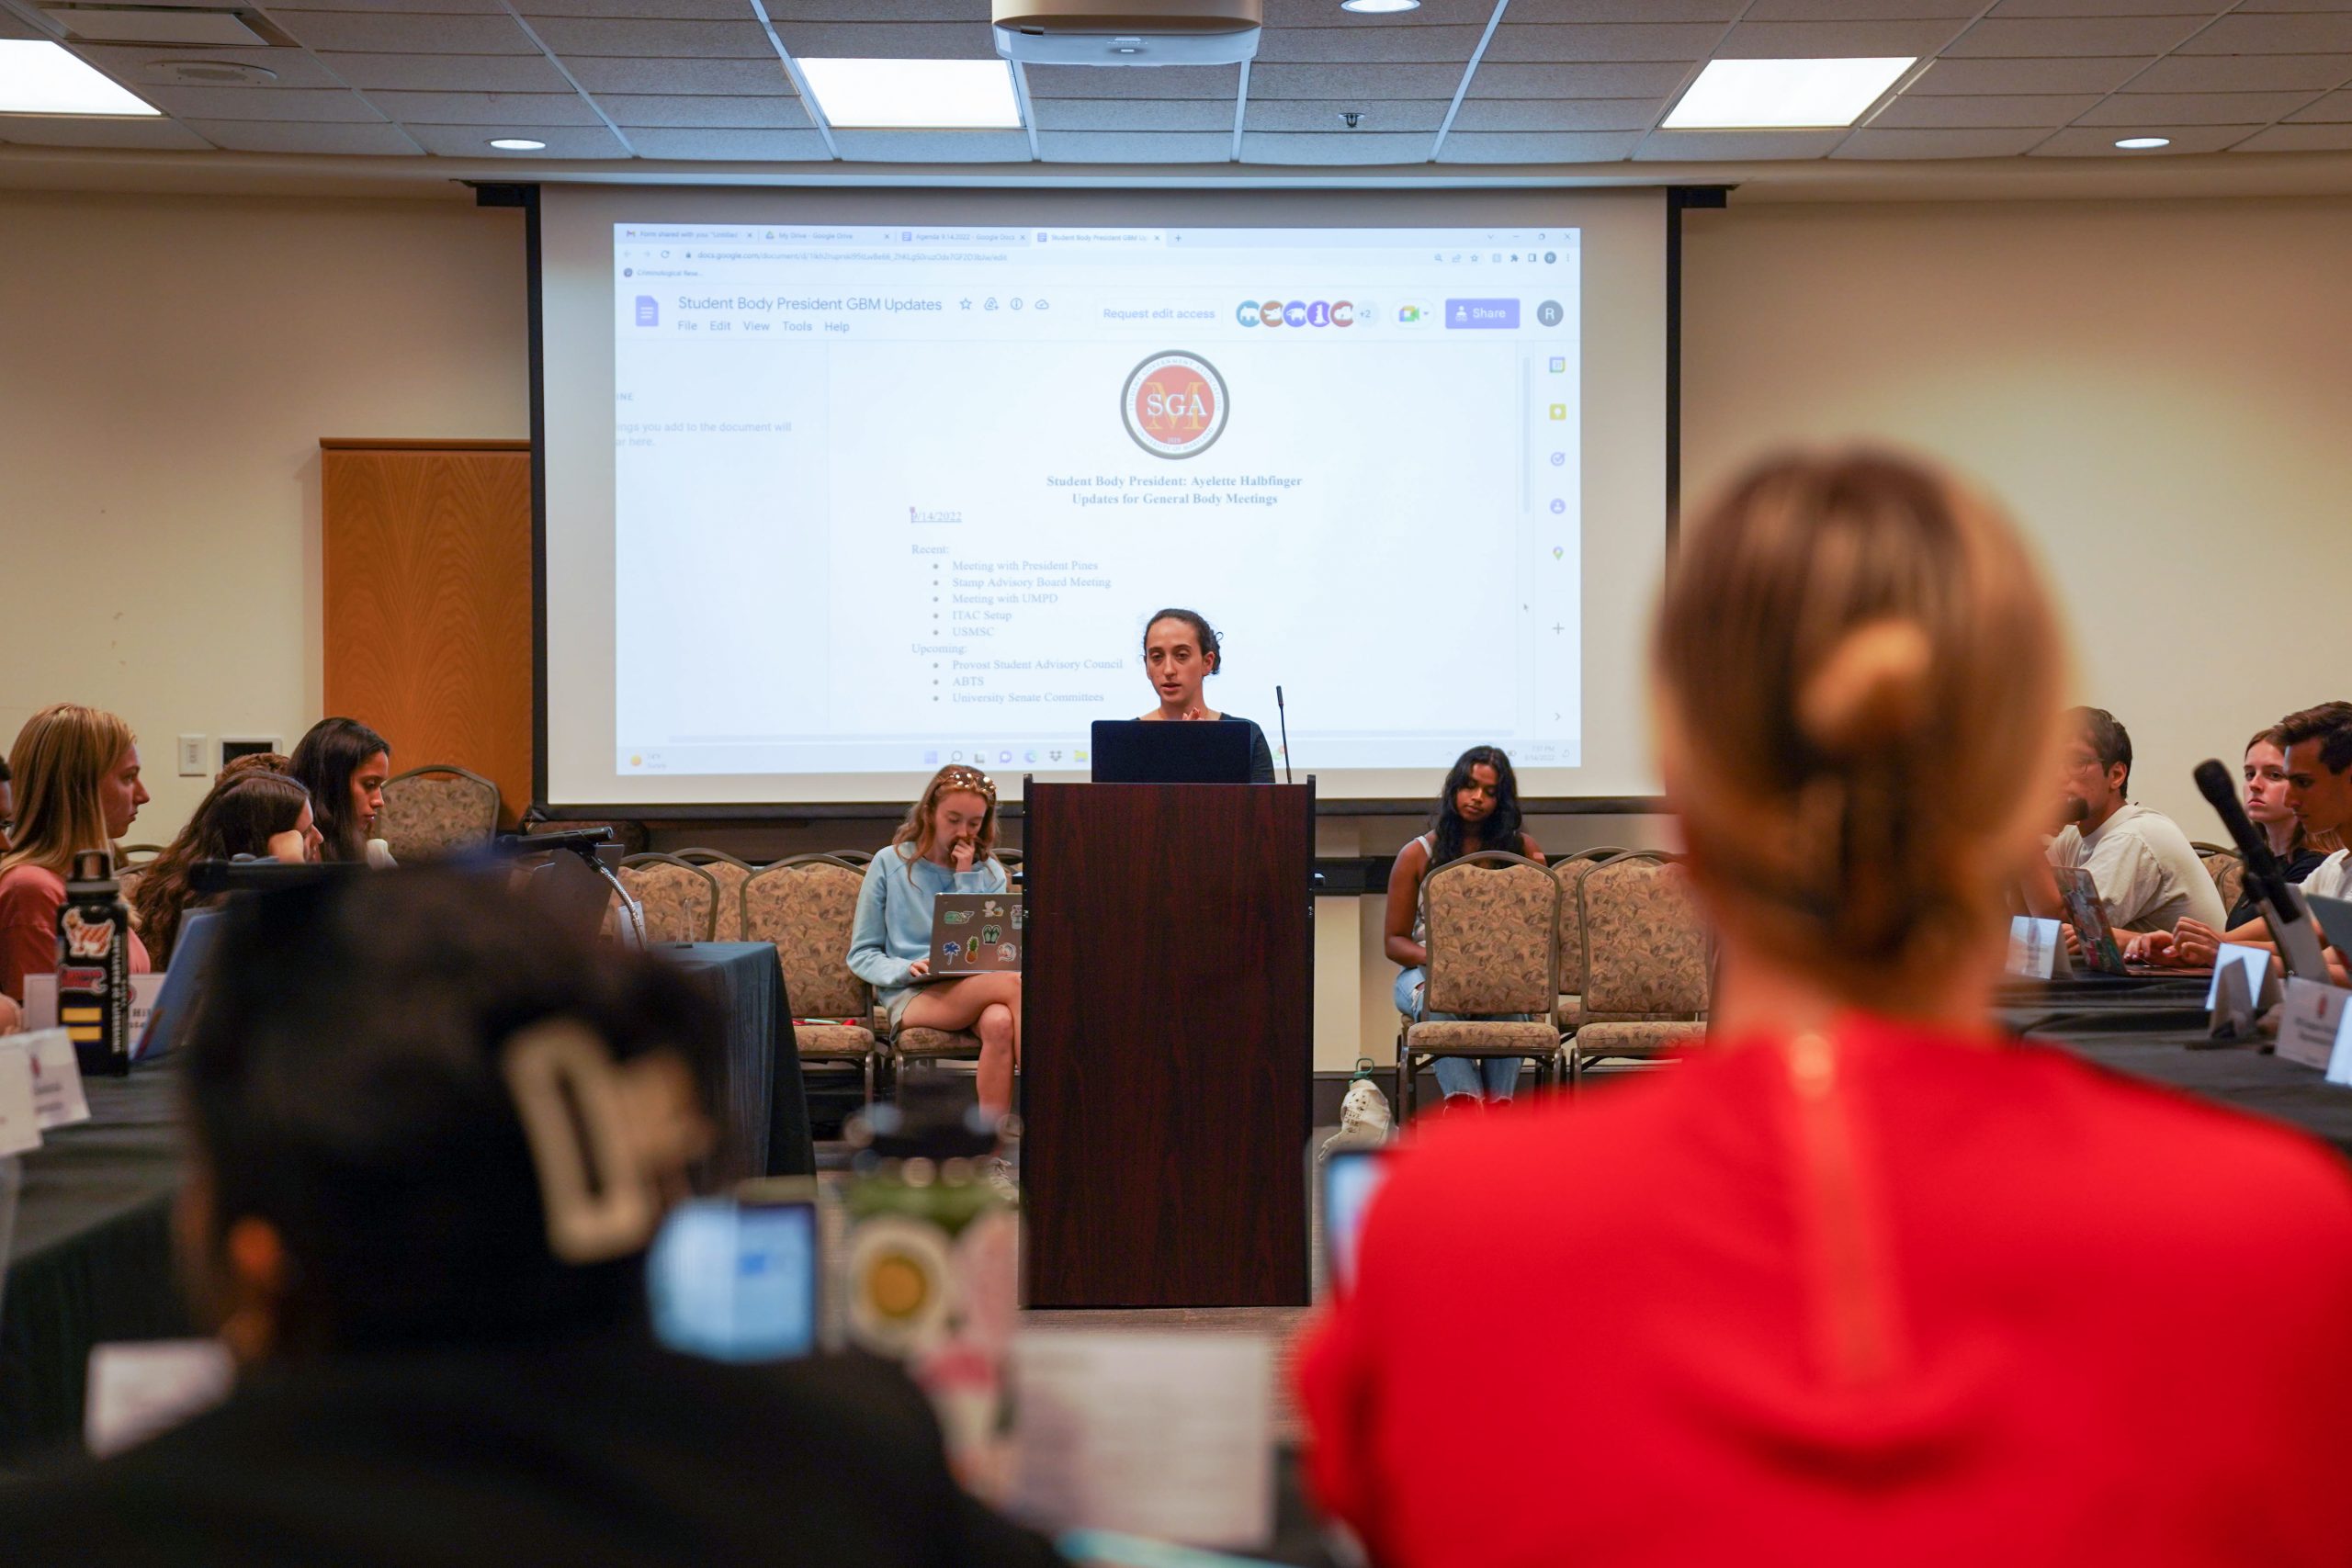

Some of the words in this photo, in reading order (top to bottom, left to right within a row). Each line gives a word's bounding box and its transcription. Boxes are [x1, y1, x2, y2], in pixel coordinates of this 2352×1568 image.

[794, 231, 809, 240] Drive
[813, 231, 835, 242] Google
[837, 231, 853, 241] Drive
[977, 233, 998, 243] Google
[1000, 233, 1015, 242] Docs
[678, 296, 733, 310] Student
[737, 297, 774, 314] Body
[777, 297, 842, 310] President
[847, 298, 882, 311] GBM
[885, 298, 942, 315] Updates
[1103, 308, 1148, 321] Request
[1152, 308, 1174, 320] edit
[1178, 310, 1216, 320] access
[1473, 308, 1506, 319] Share
[1544, 308, 1555, 320] R
[678, 321, 698, 332] File
[709, 321, 731, 332] Edit
[744, 321, 770, 332] View
[783, 321, 812, 333] Tools
[825, 321, 850, 334] Help
[1147, 392, 1207, 416] SGA
[641, 424, 662, 434] you
[664, 423, 684, 432] add
[687, 423, 697, 432] to
[700, 423, 717, 432] the
[719, 422, 771, 432] document
[775, 422, 792, 432] will
[628, 437, 655, 446] here.
[1046, 475, 1092, 487] Student
[1096, 475, 1125, 489] Body
[1129, 475, 1187, 487] President:
[1191, 475, 1237, 490] Ayelette
[1240, 475, 1302, 489] Halbfinger
[1072, 492, 1120, 506] Updates
[1123, 492, 1140, 504] for
[1143, 492, 1191, 504] General
[1193, 492, 1222, 506] Body
[1226, 492, 1278, 506] Meetings
[911, 544, 949, 555] Recent:
[952, 561, 995, 573] Meeting
[997, 561, 1019, 570] with
[1022, 561, 1069, 570] President
[1071, 561, 1098, 570] Pines
[952, 577, 984, 589] Stamp
[987, 577, 1034, 589] Advisory
[1036, 577, 1067, 586] Board
[1069, 577, 1112, 589] Meeting
[952, 593, 995, 605] Meeting
[997, 593, 1019, 603] with
[1022, 593, 1058, 603] UMPD
[952, 610, 981, 620] ITAC
[983, 610, 1012, 623] Setup
[952, 626, 995, 636] USMSC
[911, 644, 967, 655] Upcoming:
[952, 660, 991, 669] Provost
[993, 660, 1032, 669] Student
[1035, 660, 1080, 671] Advisory
[1083, 660, 1123, 669] Council
[952, 676, 984, 686] ABTS
[952, 693, 1005, 705] University
[1008, 693, 1041, 702] Senate
[1044, 693, 1104, 702] Committees
[112, 934, 121, 985] MARYLAND
[112, 1001, 121, 1053] UNIVERSITY
